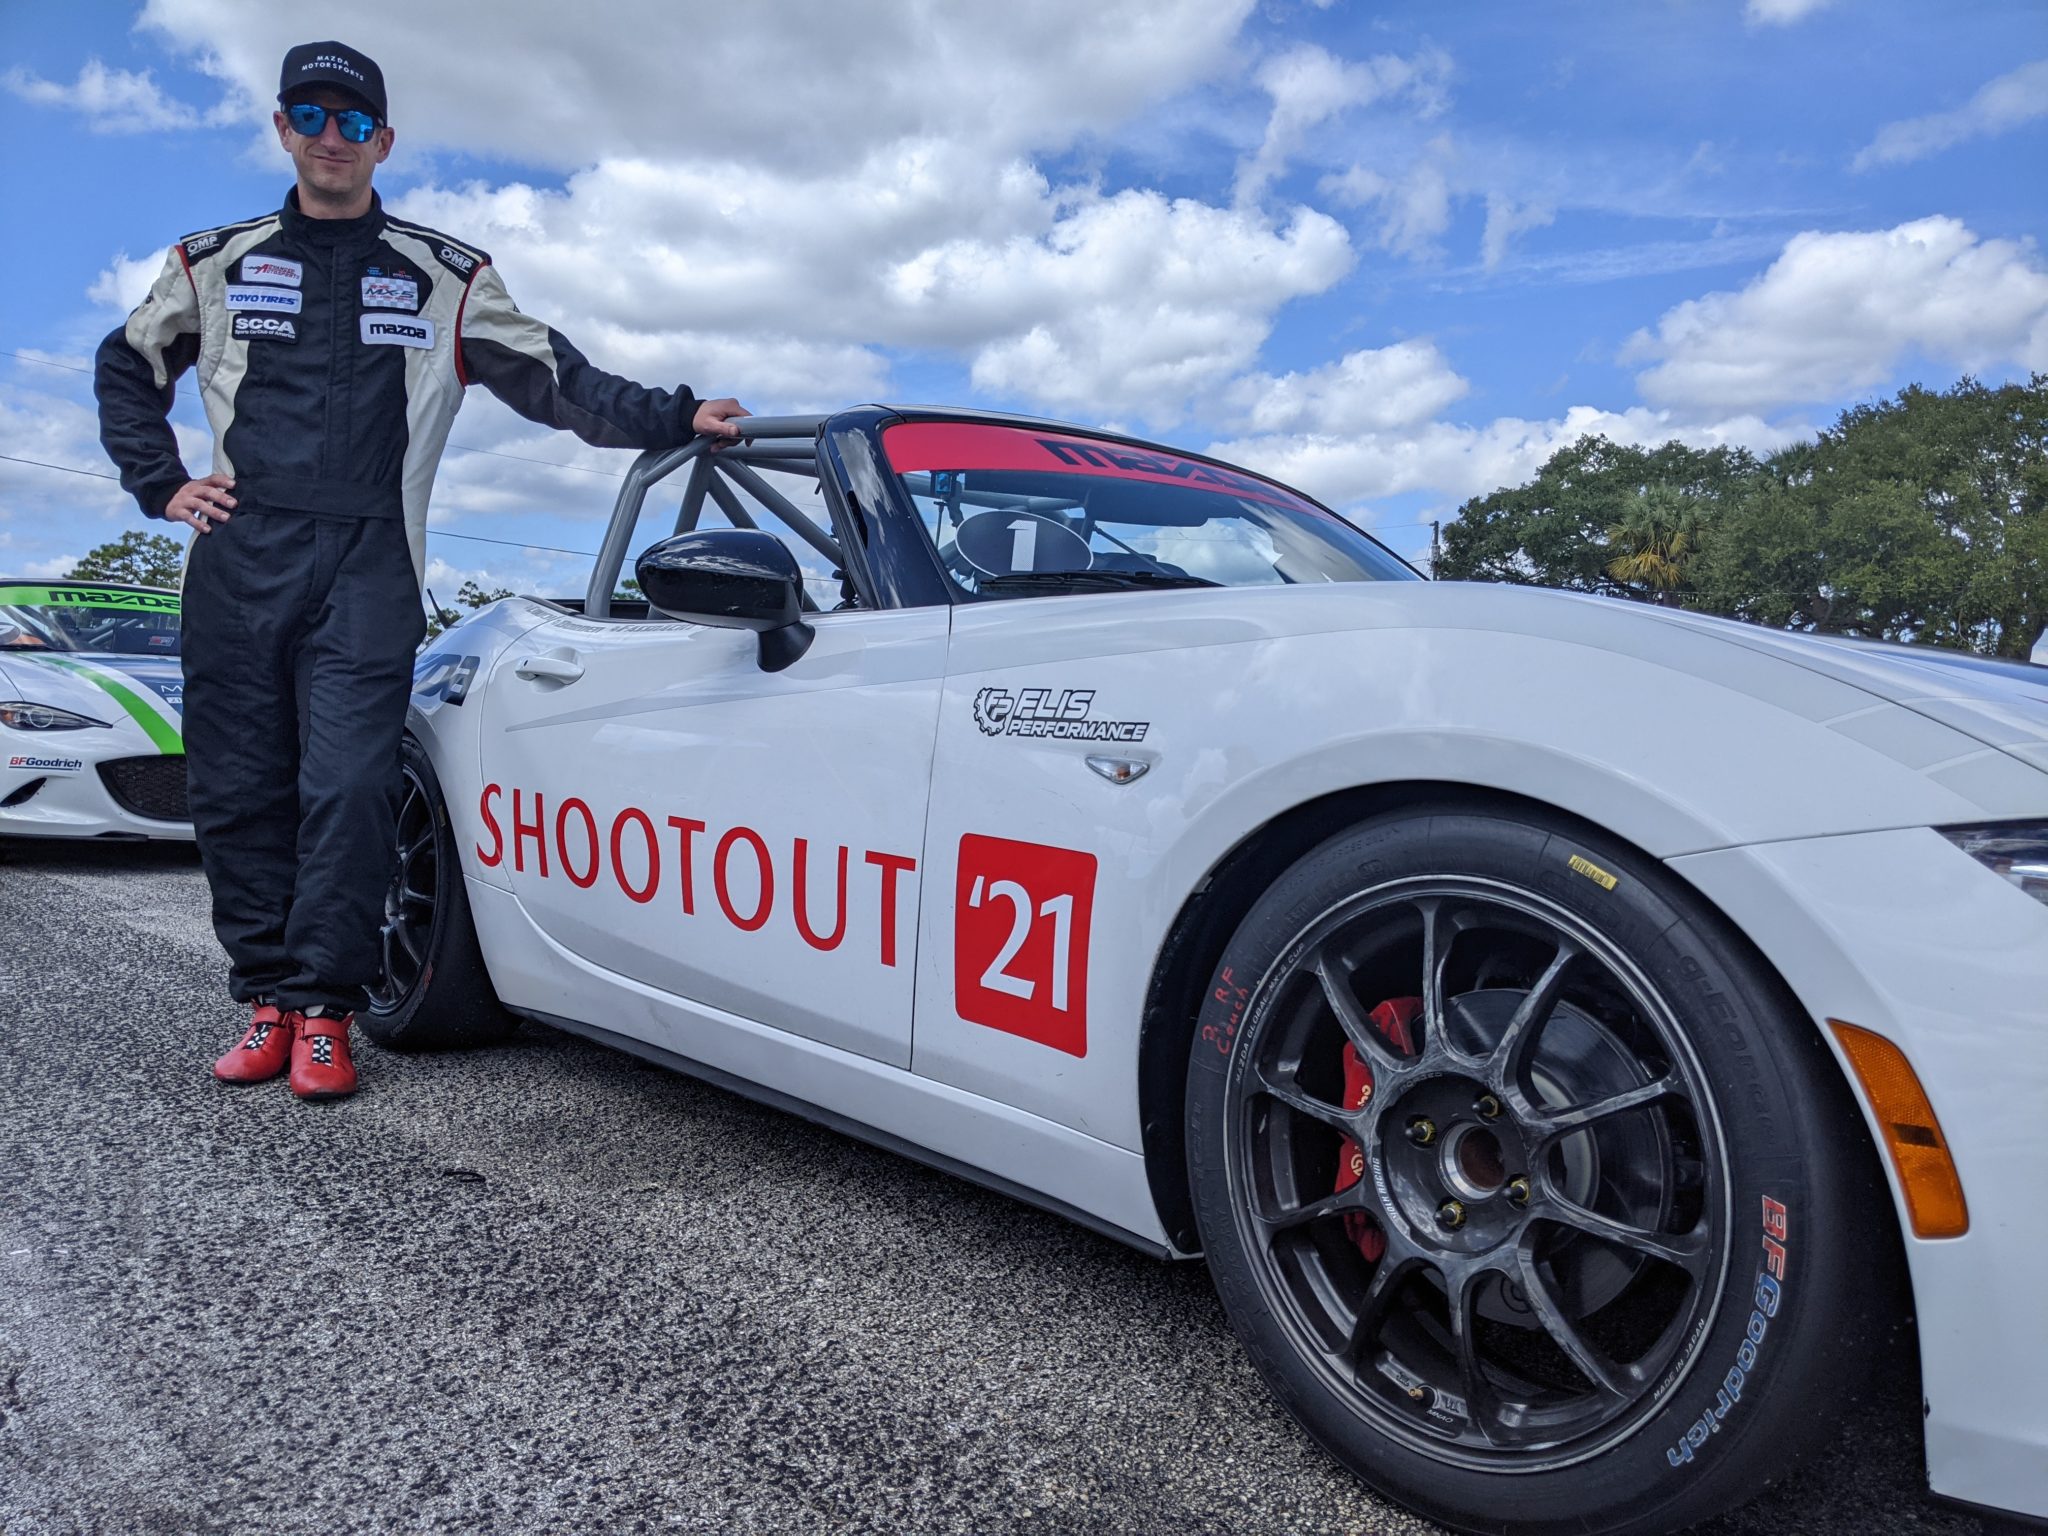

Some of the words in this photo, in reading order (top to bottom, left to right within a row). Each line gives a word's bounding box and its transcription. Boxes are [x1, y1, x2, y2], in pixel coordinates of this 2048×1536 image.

[301, 62, 364, 81] MOTORSPORTS
[316, 55, 349, 67] MAZDA
[187, 235, 218, 253] OMP
[440, 247, 473, 271] OMP
[229, 294, 260, 303] TOYO
[260, 295, 296, 306] TIRES
[365, 287, 415, 298] MX-5
[235, 318, 296, 334] SCCA
[1007, 519, 1038, 573] 1
[1014, 688, 1097, 720] FLIS
[1006, 719, 1150, 742] PERFORMANCE
[9, 756, 83, 769] BFGoodrich
[475, 783, 917, 968] SHOOTOUT
[1235, 1042, 1249, 1084] MAZDA
[1246, 995, 1269, 1038] GLOBAL
[1287, 942, 1305, 964] CUP
[1666, 1194, 1787, 1467] BFGoodrich
[1653, 1375, 1675, 1400] MADE
[1675, 1358, 1685, 1373] IN
[1683, 1318, 1705, 1360] JAPAN
